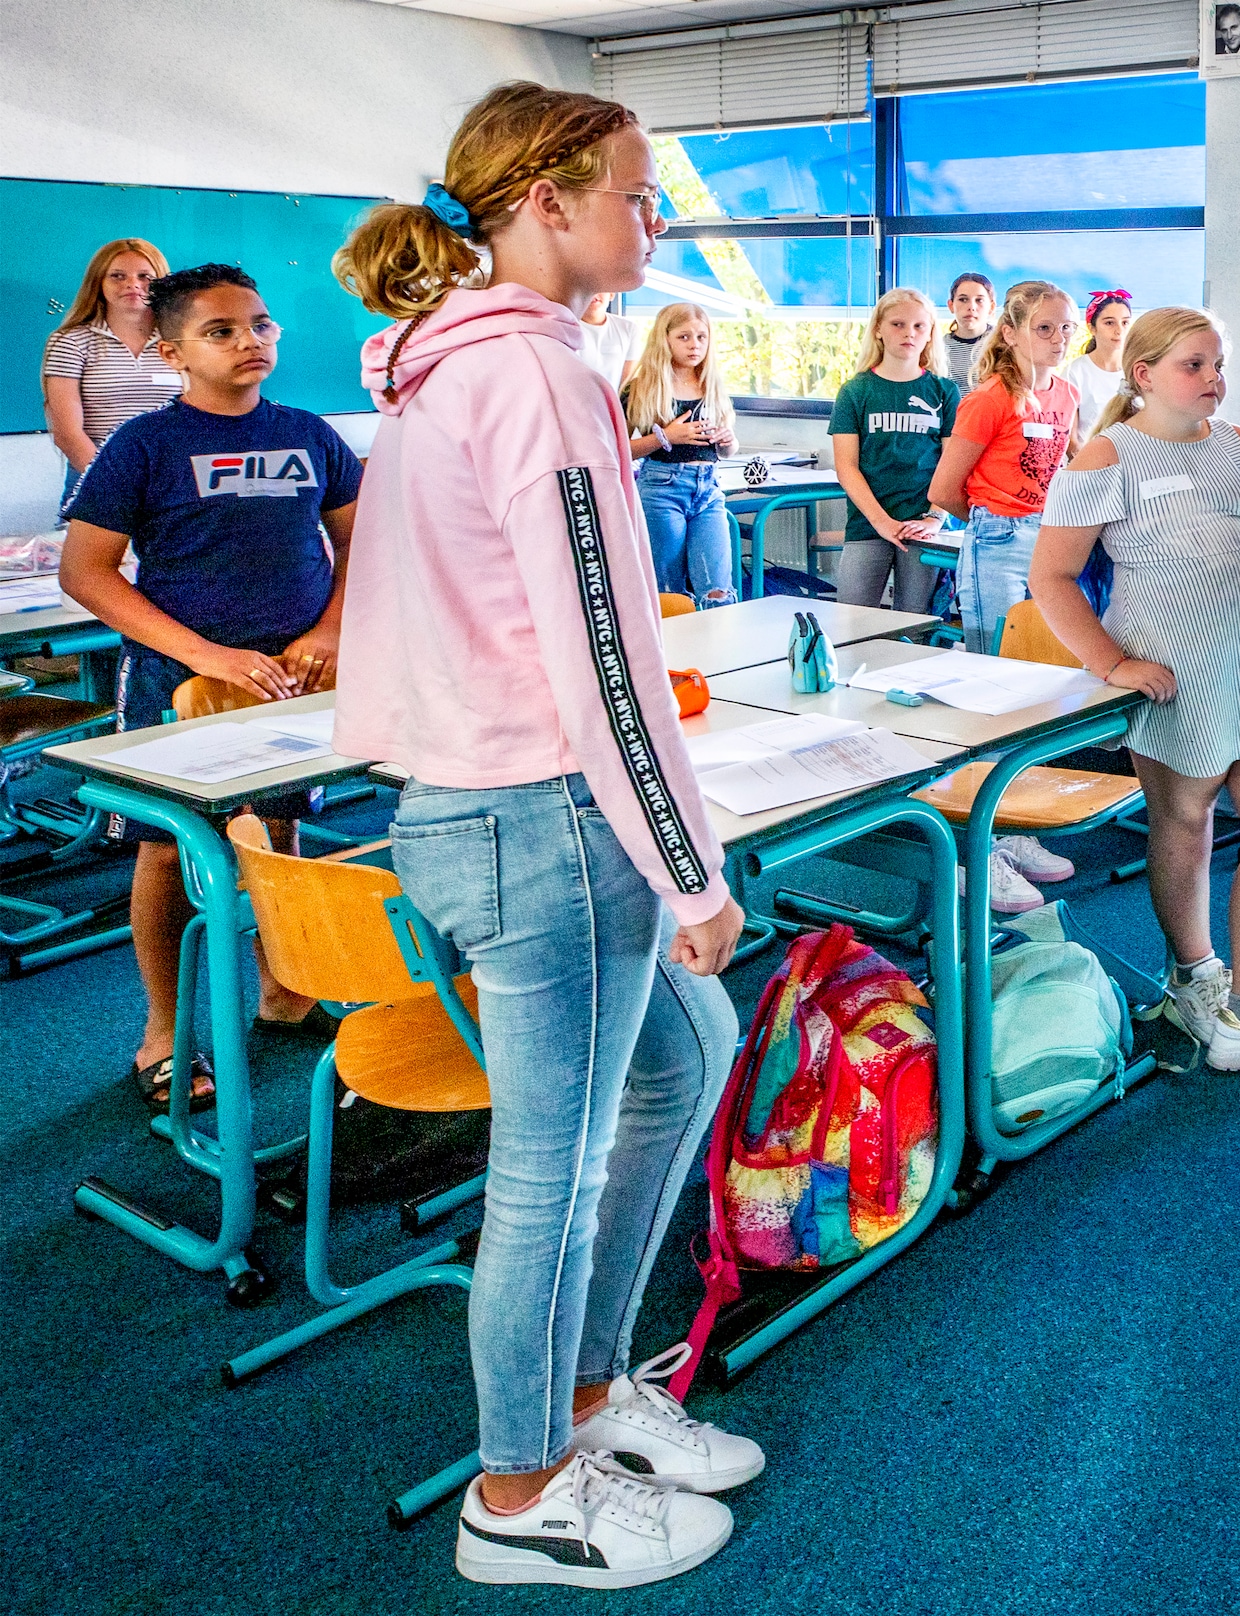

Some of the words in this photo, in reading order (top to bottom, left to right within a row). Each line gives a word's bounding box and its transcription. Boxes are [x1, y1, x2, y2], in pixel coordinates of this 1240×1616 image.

[208, 453, 310, 490] FILA
[567, 468, 586, 502] NYC
[577, 514, 595, 549] NYC
[585, 561, 604, 596] NYC
[593, 608, 613, 643] NYC
[602, 653, 623, 688] NYC
[614, 698, 636, 732] NYC
[628, 740, 651, 772] NYC
[643, 780, 667, 812] NYC
[659, 819, 681, 849] NYC
[676, 857, 700, 886] NYC
[541, 1520, 568, 1529] PUMA
